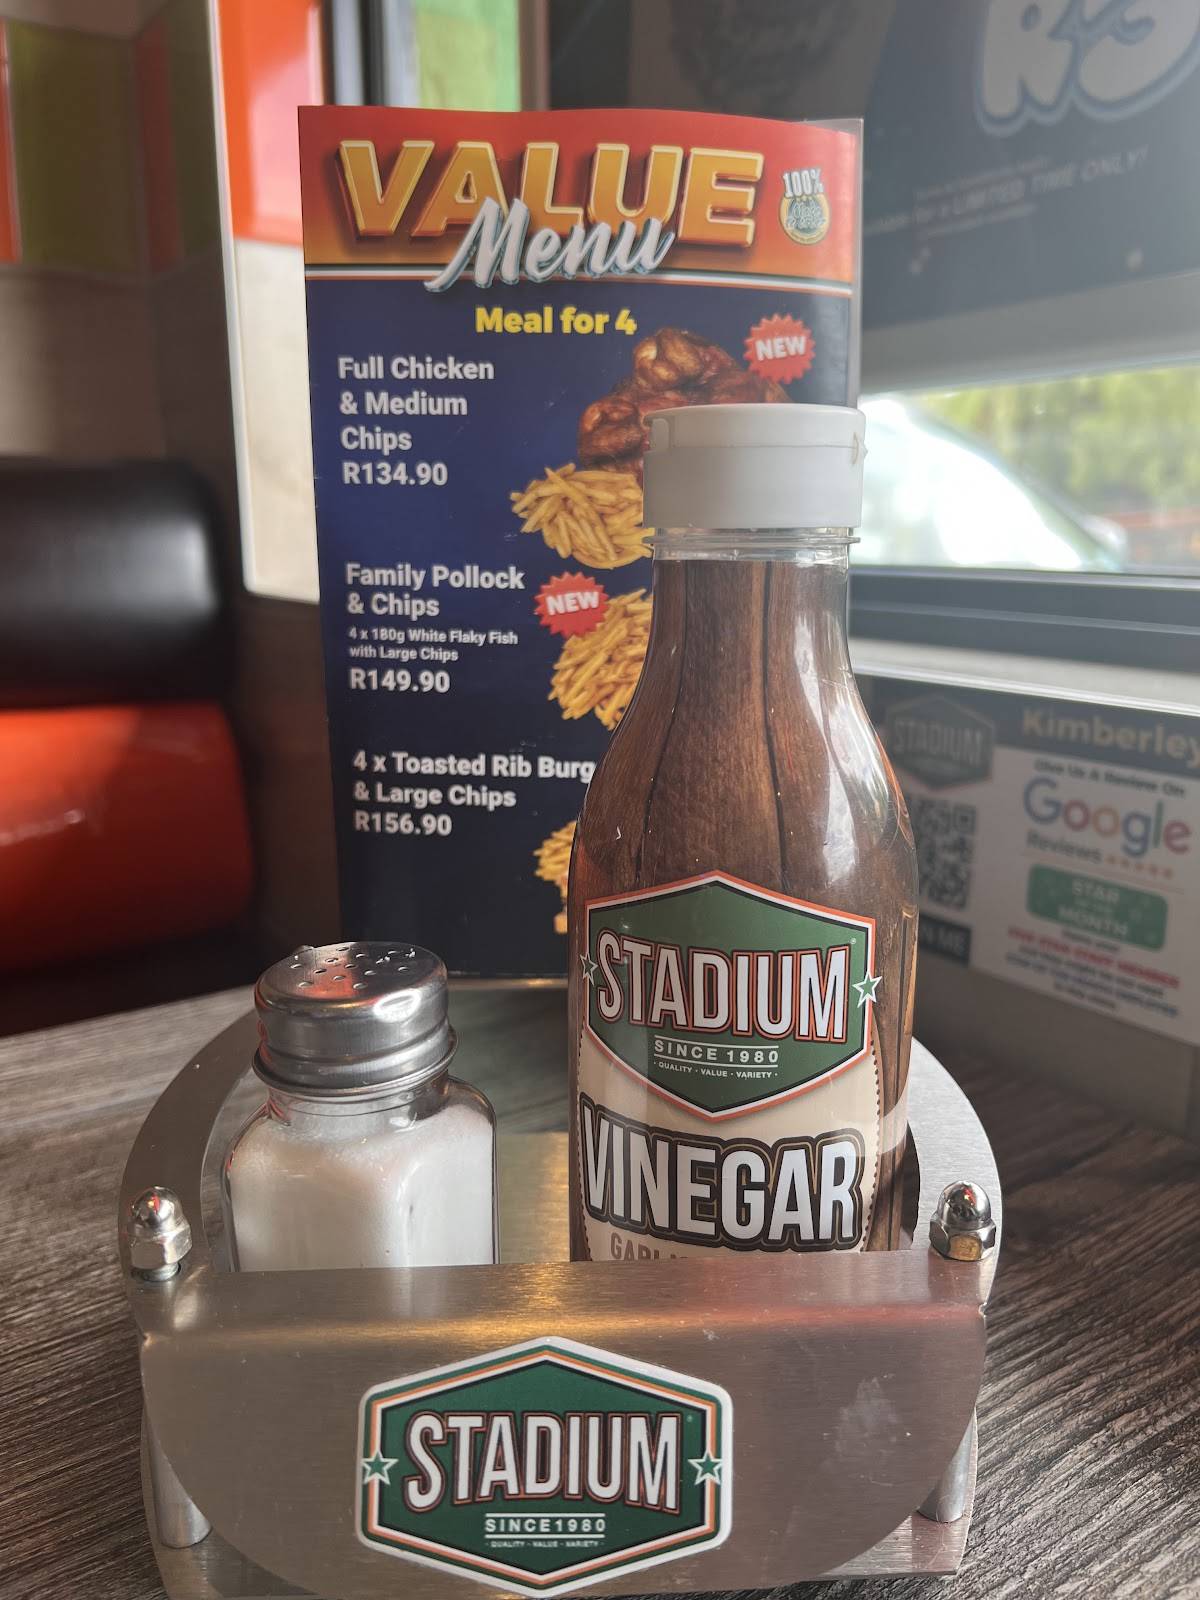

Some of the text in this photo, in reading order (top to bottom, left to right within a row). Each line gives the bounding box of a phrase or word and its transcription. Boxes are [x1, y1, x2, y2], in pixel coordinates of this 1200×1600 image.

[336, 139, 766, 248] VALUE
[782, 168, 824, 198] 100%
[424, 196, 678, 294] Menu
[474, 306, 638, 335] Meal for 4
[755, 335, 807, 361] NEW
[337, 356, 496, 381] Full Chicken
[338, 390, 469, 417] & Medium
[340, 426, 413, 455] Chips
[342, 462, 449, 486] R134.90
[345, 563, 525, 592] Family Pollock
[346, 593, 441, 622] & Chips
[546, 590, 600, 616] NEW
[349, 628, 519, 648] 4 x 180g White Flaky Fish
[349, 644, 460, 664] with Large Chips
[350, 668, 451, 693] R149.90
[353, 750, 596, 783] 4 x Toasted Rib Burg
[354, 781, 516, 811] & Large Chips
[354, 811, 452, 836] R156.90
[1023, 776, 1192, 858] Google
[597, 930, 853, 1044] STADIUM
[654, 1039, 779, 1063] SINCE 1980
[658, 1061, 773, 1080] QUALITY VALUE VARIETY
[580, 1098, 864, 1247] VINEGAR
[404, 1410, 682, 1514] STADIUM
[485, 1518, 606, 1533] SINCE 1980
